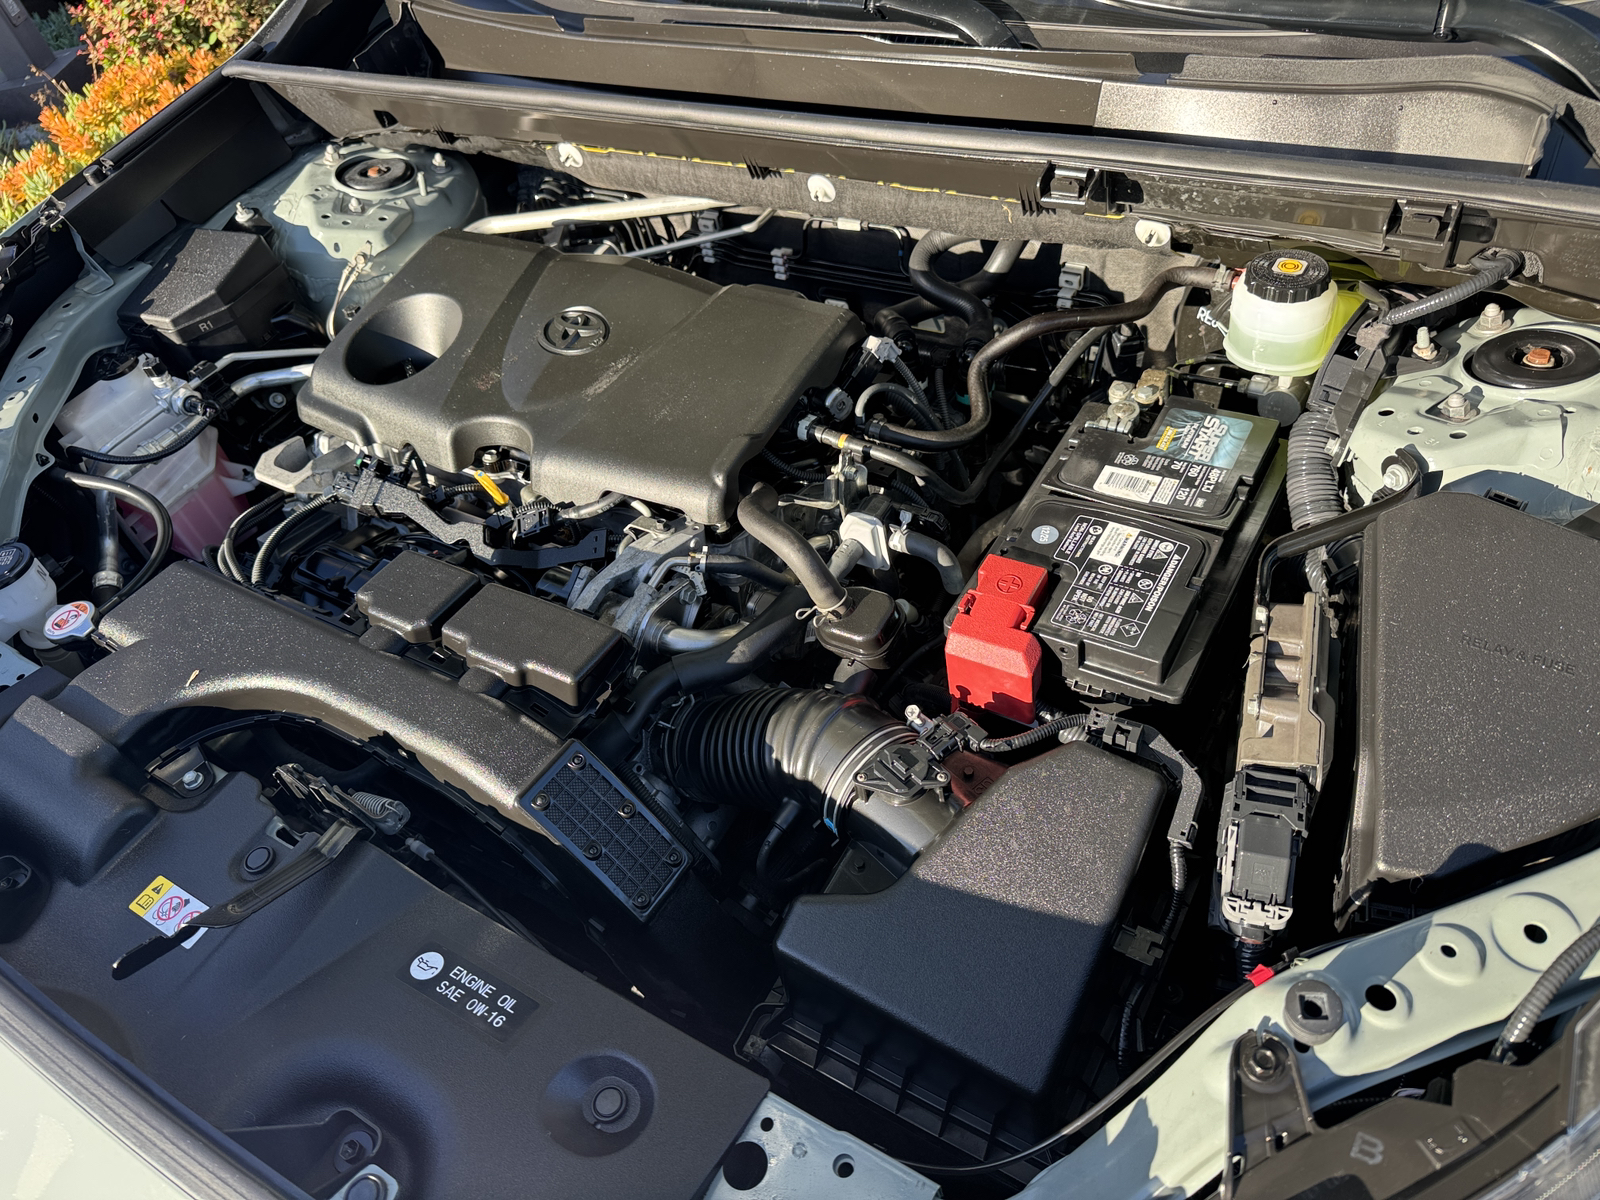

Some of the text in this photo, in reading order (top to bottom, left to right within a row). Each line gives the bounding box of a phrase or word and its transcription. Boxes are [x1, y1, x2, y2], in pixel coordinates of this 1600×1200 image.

[198, 320, 214, 333] R1
[1187, 415, 1220, 460] START
[1198, 423, 1228, 462] SUPER
[1169, 460, 1183, 470] 70
[1186, 463, 1202, 478] 760
[1174, 487, 1190, 501] 120
[1144, 559, 1179, 611] DANGER/POISON
[1461, 634, 1576, 676] RELAY & FUSE
[436, 980, 507, 1028] SAE 0W-16
[449, 966, 517, 1014] ENGINE OIL
